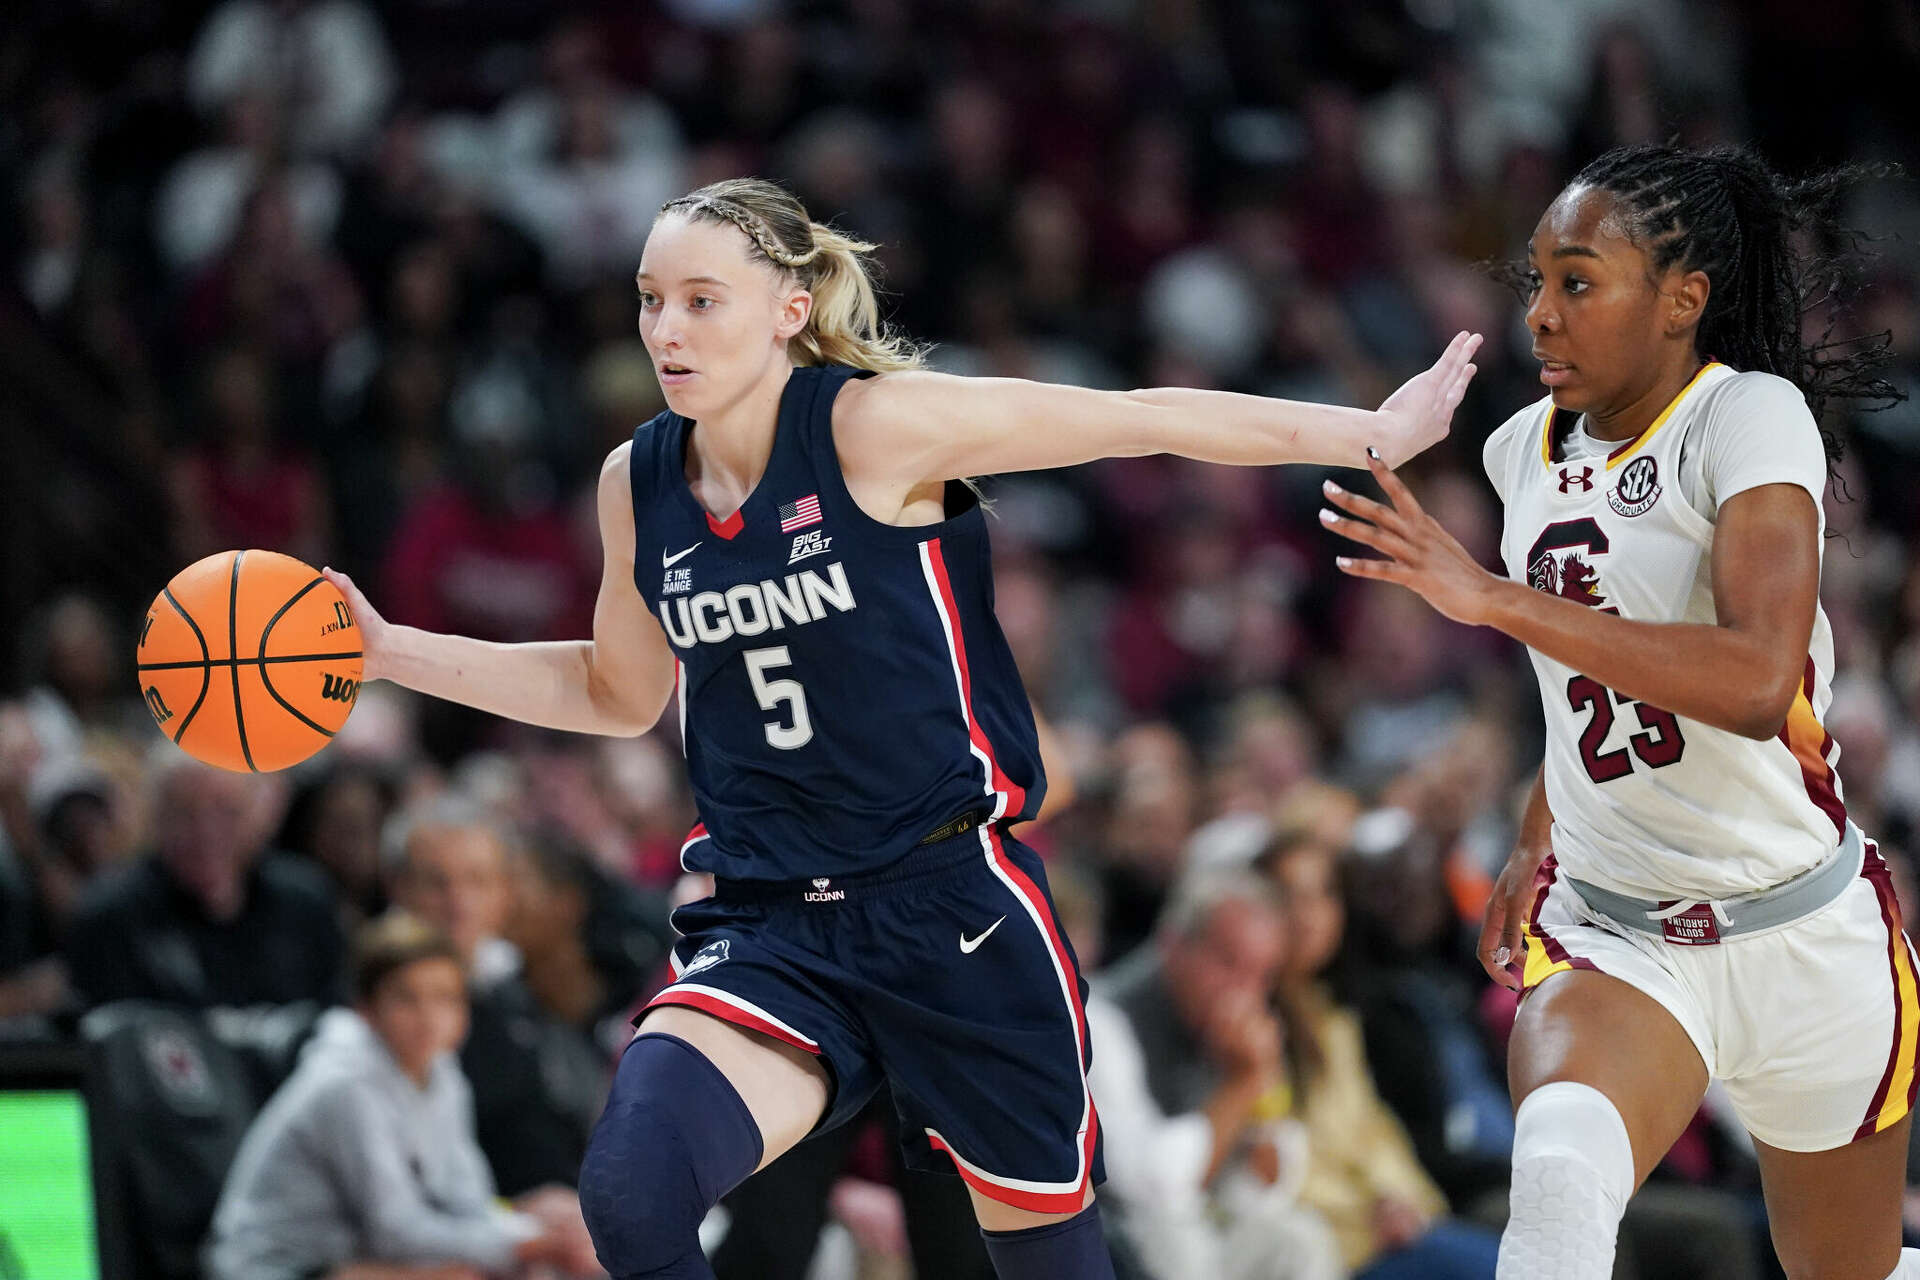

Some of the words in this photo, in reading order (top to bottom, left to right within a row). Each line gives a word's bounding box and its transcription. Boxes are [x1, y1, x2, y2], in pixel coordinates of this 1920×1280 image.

[1620, 459, 1655, 500] SEC
[1611, 497, 1652, 515] GRADUATE
[790, 536, 833, 557] EAST
[792, 530, 822, 549] BIG
[674, 568, 692, 581] THE
[659, 561, 857, 649] UCONN
[742, 645, 814, 750] 5
[1567, 674, 1686, 785] 23
[804, 890, 845, 902] UCONN
[1667, 916, 1710, 928] CAROLINA
[1675, 926, 1705, 938] SOUTH
